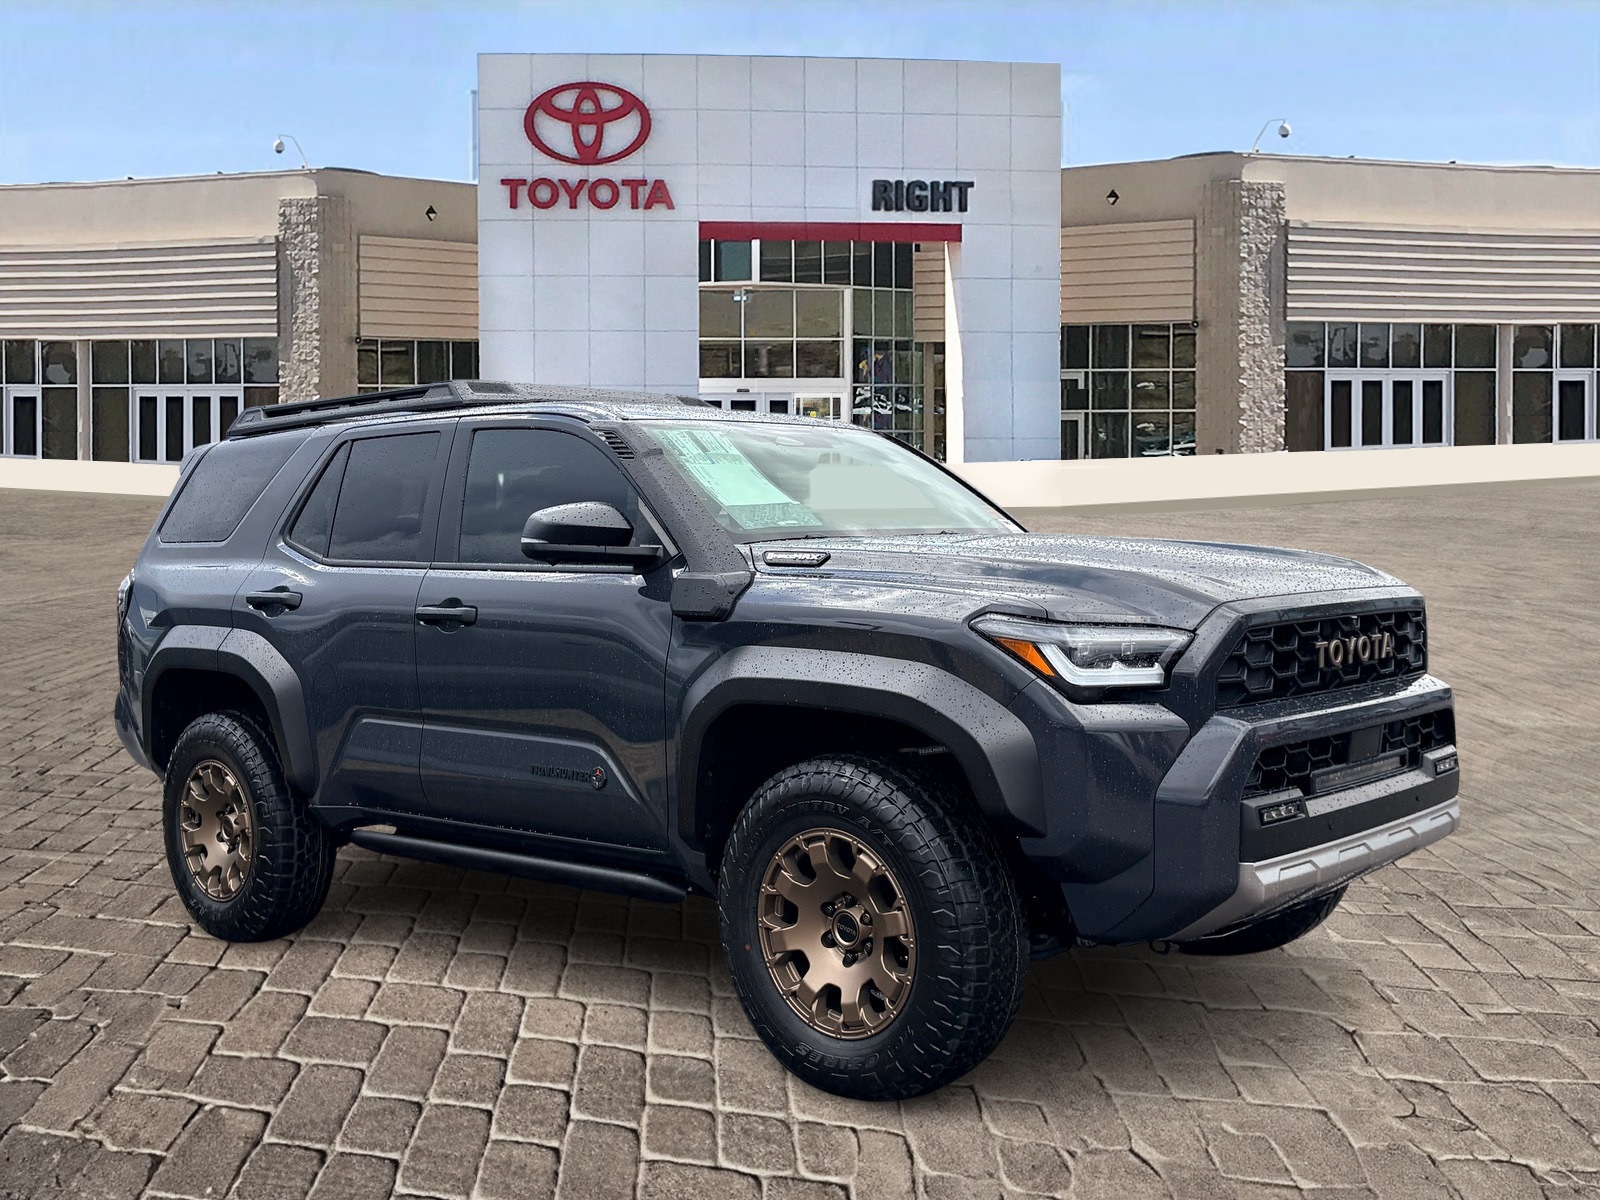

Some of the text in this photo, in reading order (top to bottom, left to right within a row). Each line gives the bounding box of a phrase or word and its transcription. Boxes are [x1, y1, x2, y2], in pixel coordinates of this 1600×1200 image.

[500, 177, 676, 210] TOYOTA
[871, 179, 975, 213] RIGHT
[1314, 631, 1394, 668] TOYOTA
[836, 922, 857, 936] TOYOTA
